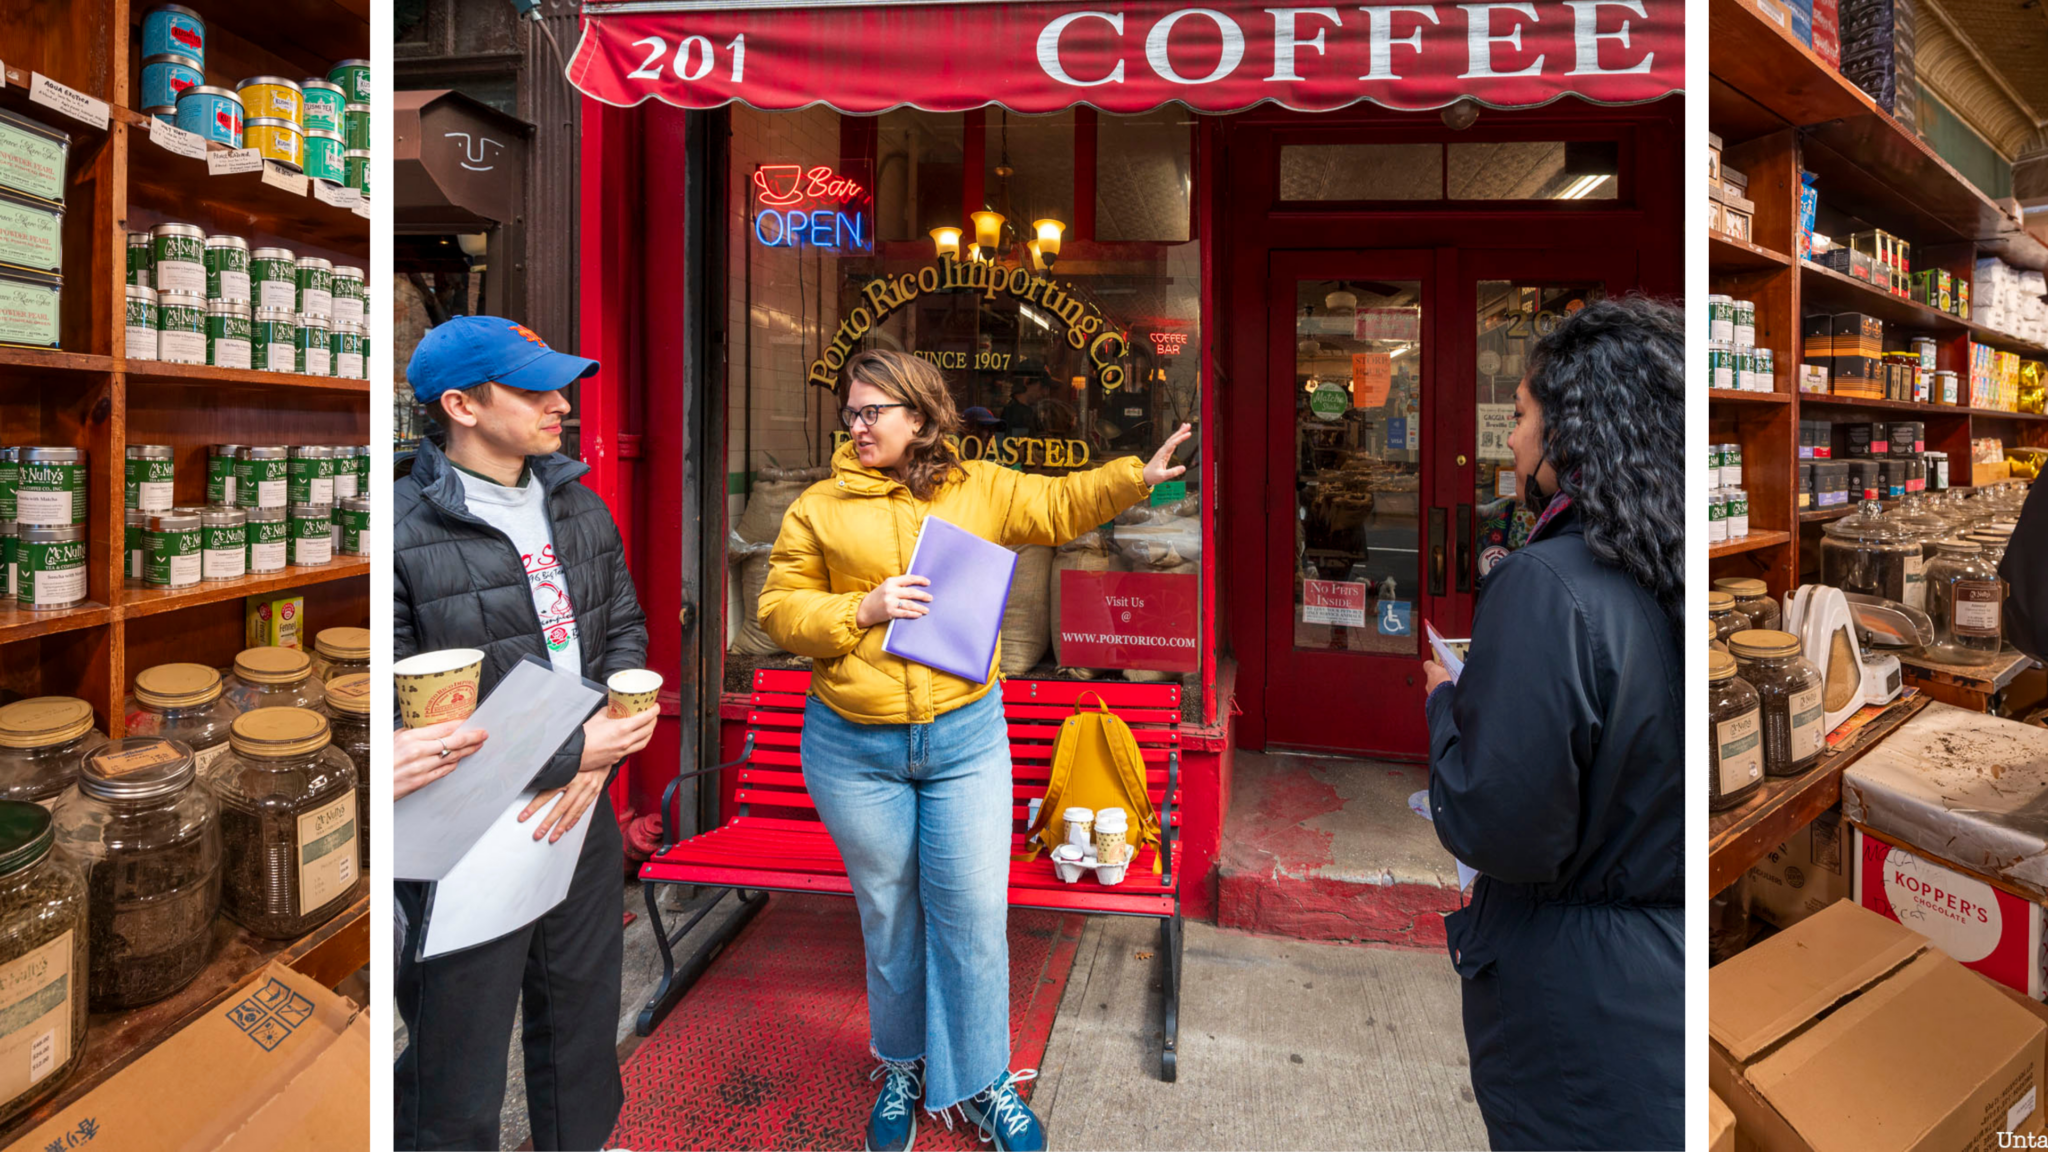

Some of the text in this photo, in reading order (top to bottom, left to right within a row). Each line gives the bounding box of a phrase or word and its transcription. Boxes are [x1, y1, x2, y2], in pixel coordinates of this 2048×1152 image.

[1036, 0, 1654, 87] COFFEE
[627, 33, 746, 83] 201
[807, 166, 861, 197] Bar
[756, 209, 862, 247] OPEN
[808, 307, 871, 391] Porto
[862, 266, 939, 318] Rico
[942, 251, 1103, 350] Importing
[1149, 332, 1188, 344] COFFEE
[1157, 344, 1180, 355] BAR
[913, 351, 1012, 370] SINCE 1907
[1355, 356, 1389, 365] STORE
[1310, 581, 1359, 596] NO PETS
[1105, 596, 1145, 608] Visit Us
[1317, 594, 1352, 607] INSIDE
[1121, 611, 1132, 623] @
[279, 621, 297, 633] Fennel
[1062, 632, 1196, 648] WWW.PORTORICO.COM
[1895, 870, 1988, 924] KOPPER'S
[1913, 895, 1967, 925] CHOCOLATE
